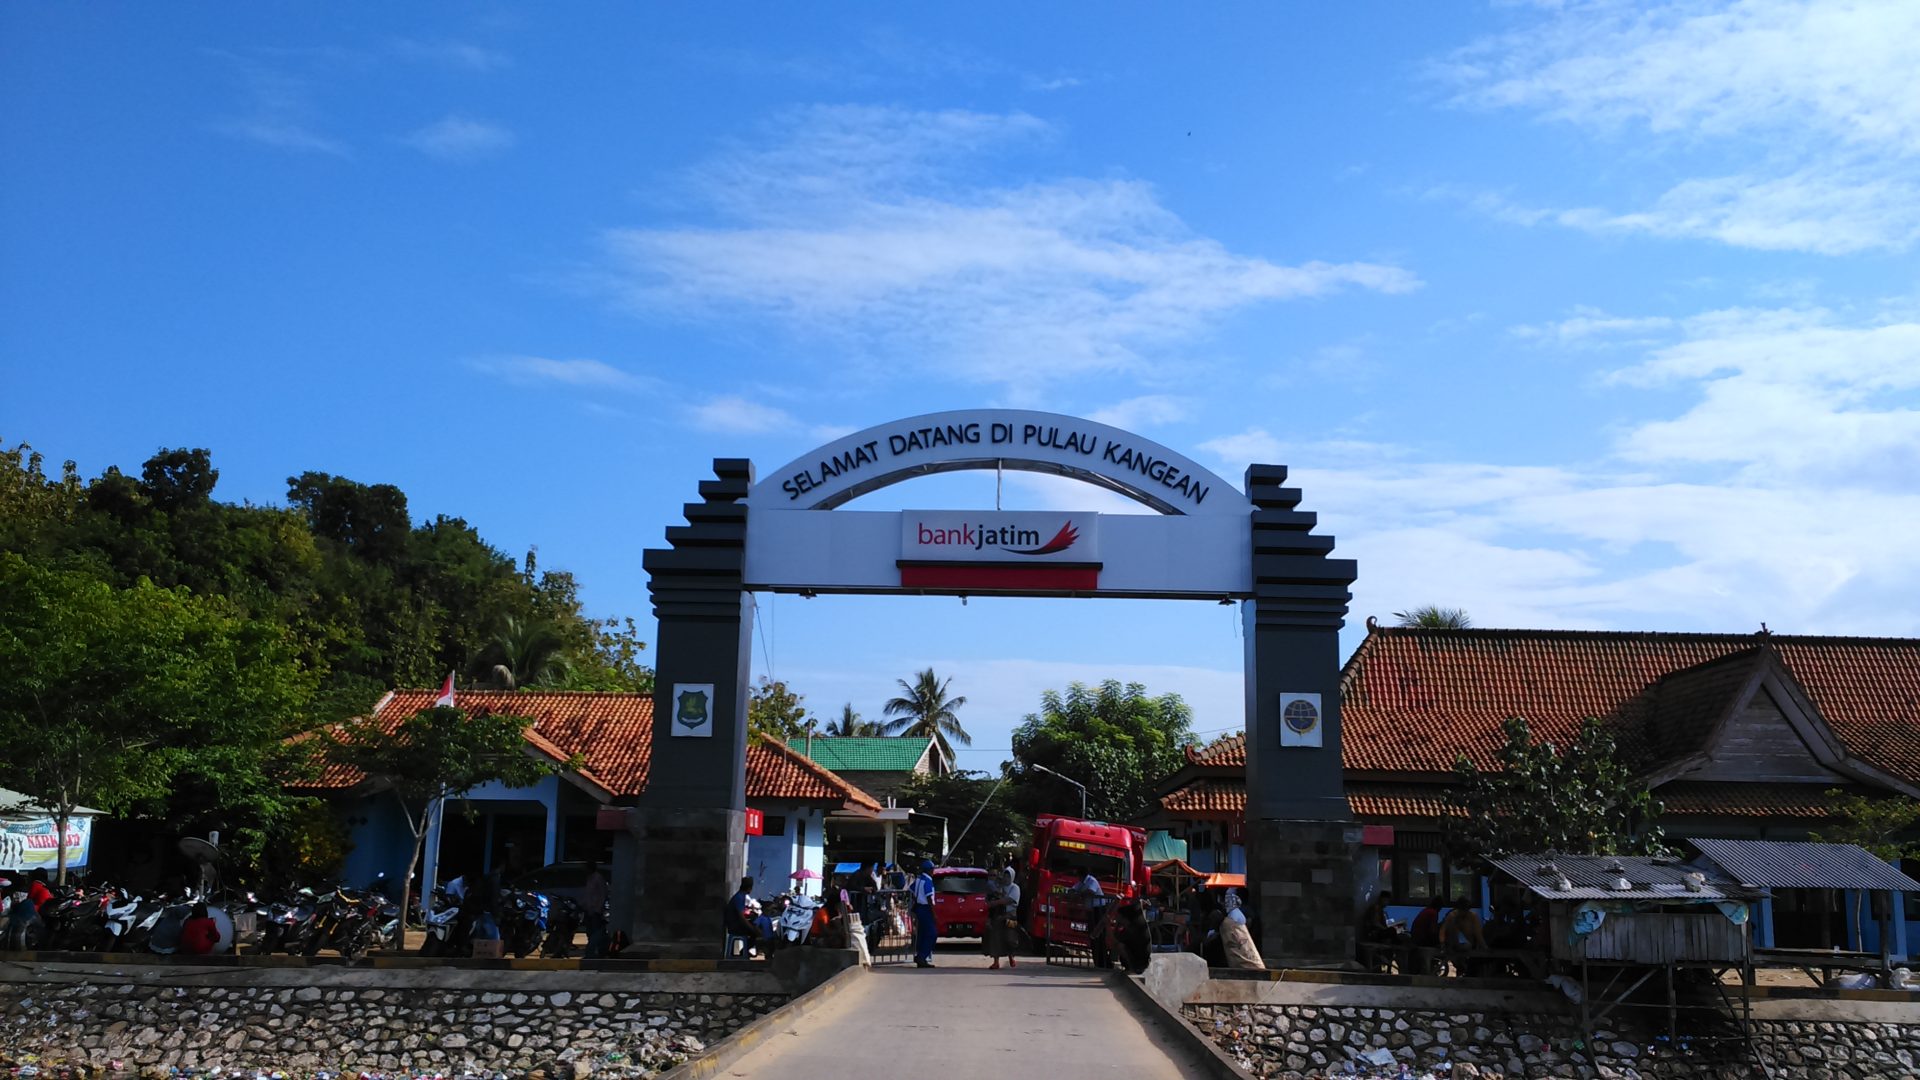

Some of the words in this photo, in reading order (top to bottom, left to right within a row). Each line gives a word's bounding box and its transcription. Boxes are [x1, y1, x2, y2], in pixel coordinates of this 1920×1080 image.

[782, 440, 880, 500] SELAMAT
[888, 423, 981, 456] DATANG
[991, 423, 1013, 444] DI
[1023, 425, 1098, 455] PULAU
[1103, 440, 1210, 505] KANGEAN
[918, 521, 1041, 551] bankjatim
